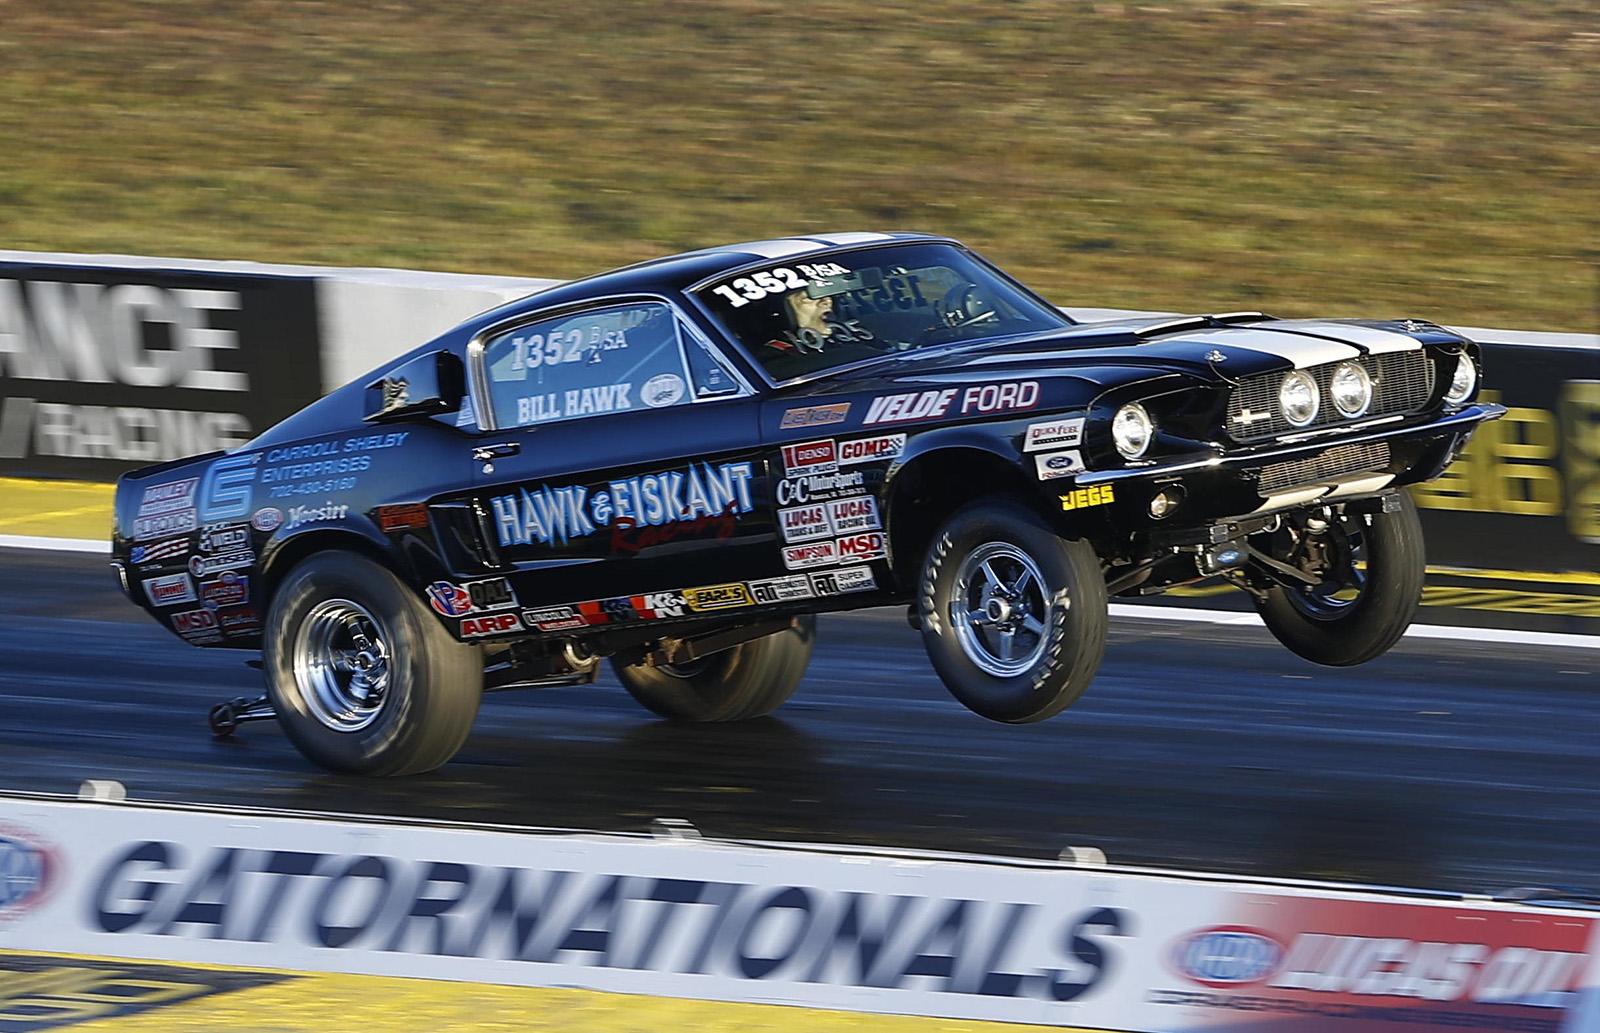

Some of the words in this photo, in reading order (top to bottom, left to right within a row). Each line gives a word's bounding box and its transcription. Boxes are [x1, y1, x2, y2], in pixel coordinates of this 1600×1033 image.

[713, 267, 809, 308] 1352
[511, 328, 582, 371] 1352
[517, 394, 560, 424] BILL
[565, 383, 632, 416] HAWK
[862, 388, 959, 427] VELDE
[961, 381, 1040, 415] FORD
[266, 441, 340, 463] CARROLL
[344, 432, 410, 453] SHELBY
[798, 447, 831, 460] DENSO
[842, 438, 890, 459] COMP
[261, 455, 372, 483] ENTERPRISES
[834, 500, 872, 519] LUCAS
[1059, 486, 1115, 510] JEGS
[491, 484, 596, 547] HAWK
[591, 491, 614, 525] &
[785, 508, 823, 528] LUCAS
[839, 533, 882, 556] MSD
[461, 616, 517, 636] ARP
[86, 839, 1135, 1002] GATORNATIONALS
